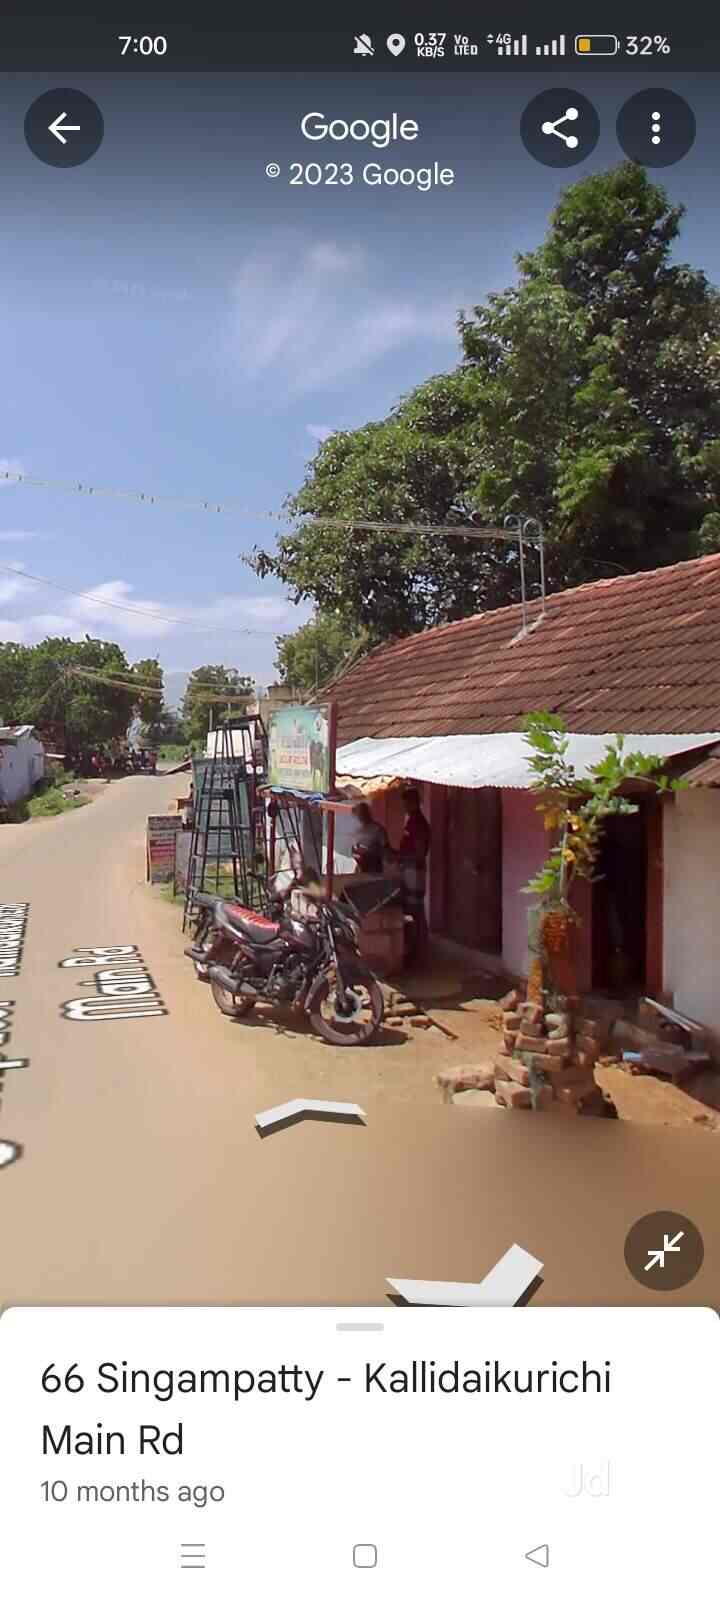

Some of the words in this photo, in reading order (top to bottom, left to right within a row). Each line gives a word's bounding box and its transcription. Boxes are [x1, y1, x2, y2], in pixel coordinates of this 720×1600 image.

[119, 36, 166, 55] 7:00
[415, 33, 446, 46] 0.37
[418, 46, 444, 58] KB/S
[626, 36, 670, 55] 32%
[302, 113, 418, 147] Google
[290, 163, 353, 185] 2023
[363, 162, 454, 191] Google
[42, 1364, 84, 1392] 66
[98, 1361, 323, 1401] Singampatty
[366, 1361, 610, 1392] Kallidaikurichi
[43, 1423, 124, 1454] Main
[140, 1423, 182, 1454] Rd
[41, 1481, 67, 1501] 10
[78, 1479, 169, 1501] months
[178, 1486, 224, 1507] ago
